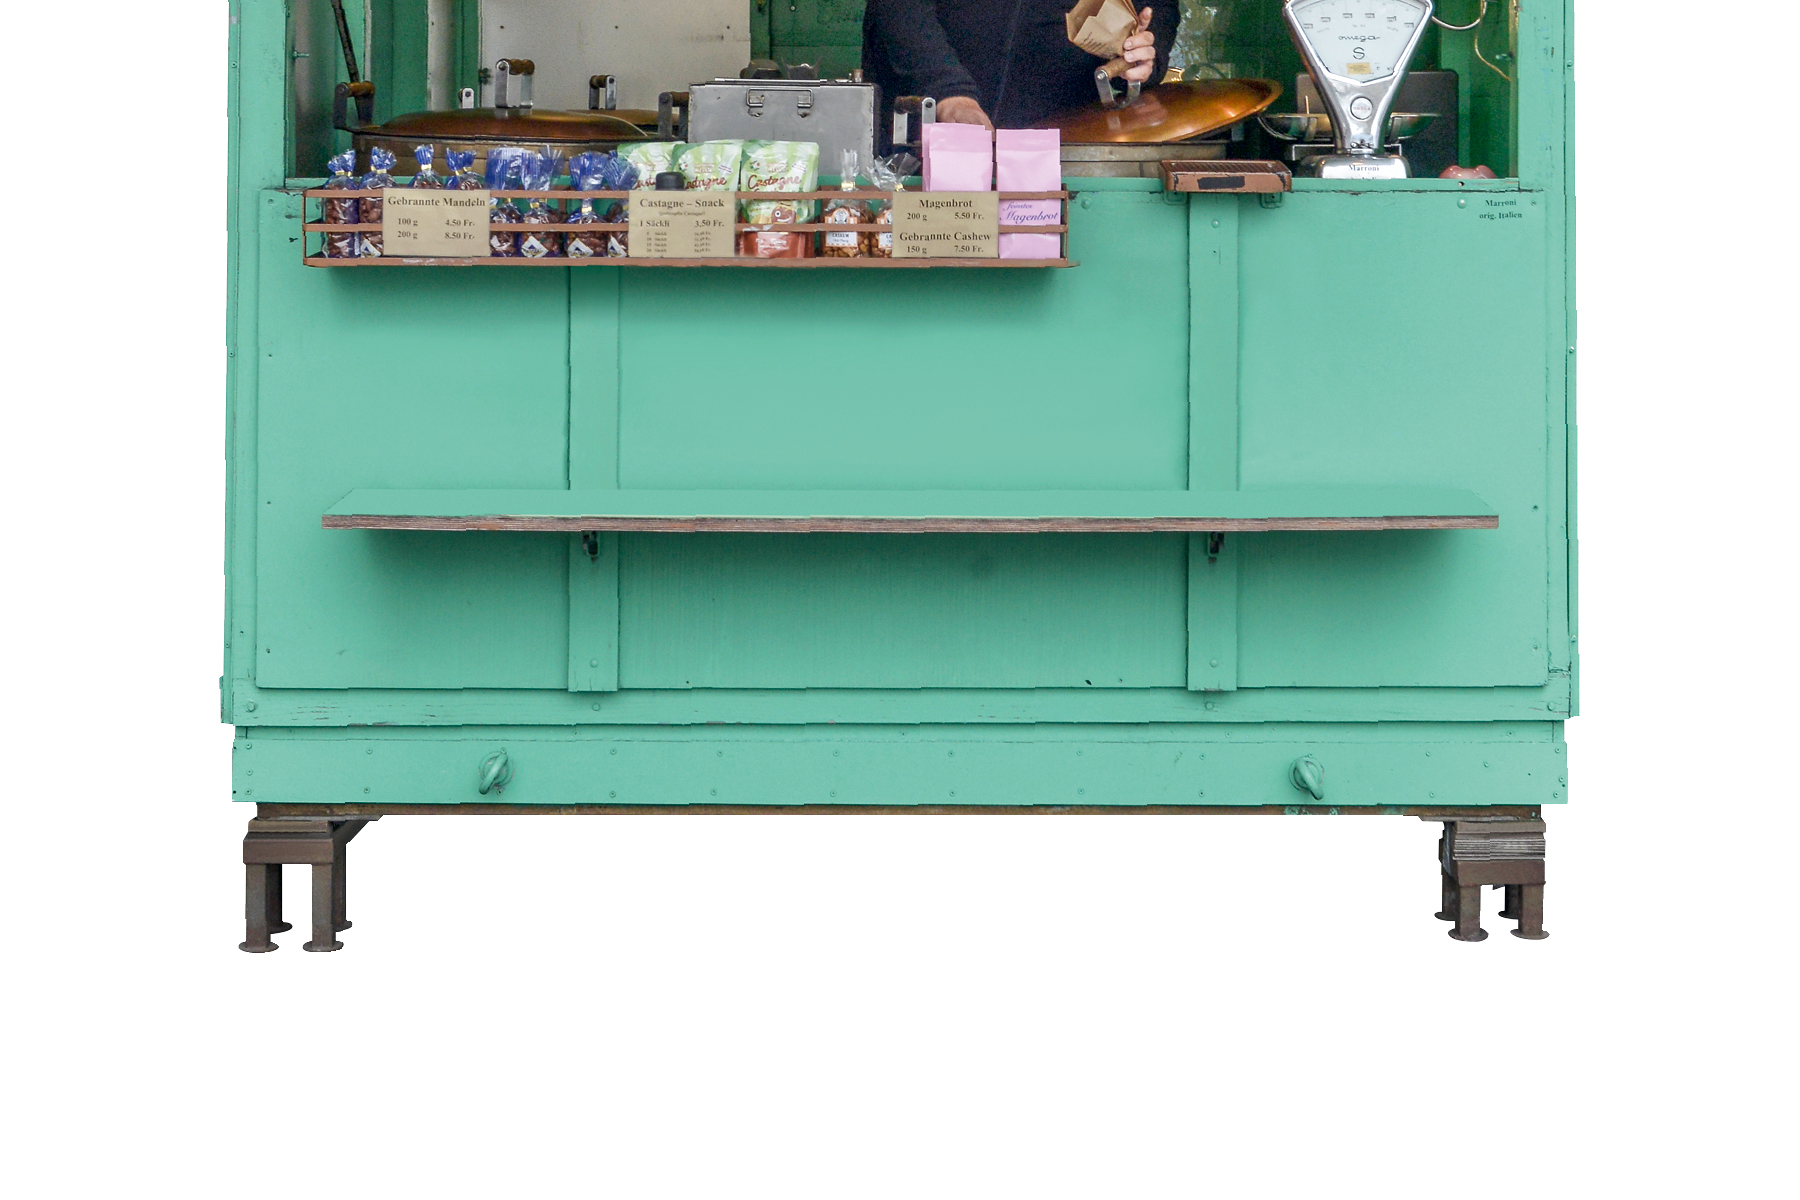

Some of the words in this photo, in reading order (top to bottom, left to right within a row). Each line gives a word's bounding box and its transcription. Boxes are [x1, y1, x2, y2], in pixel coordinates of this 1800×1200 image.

[1352, 47, 1365, 60] S
[747, 174, 801, 190] Castagne
[387, 197, 439, 206] Gebrannte
[442, 198, 485, 206] Mandeln
[639, 199, 684, 209] Castagne
[695, 199, 724, 207] Snack
[919, 199, 971, 208] Magenbrot
[1000, 211, 1058, 224] Magenbrot
[1479, 212, 1496, 220] orig.
[1498, 211, 1522, 219] Italien
[899, 233, 950, 241] Gebrannte
[953, 232, 989, 240] Cashew
